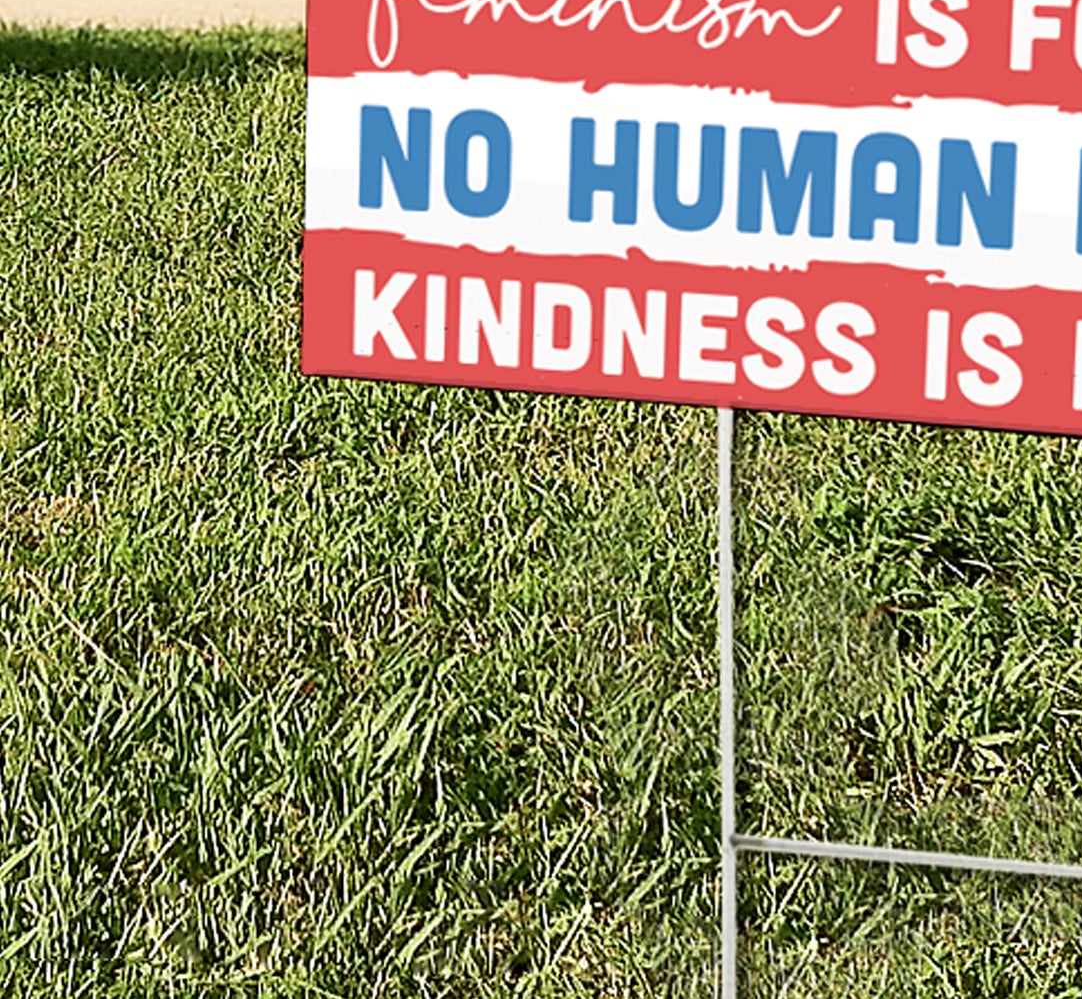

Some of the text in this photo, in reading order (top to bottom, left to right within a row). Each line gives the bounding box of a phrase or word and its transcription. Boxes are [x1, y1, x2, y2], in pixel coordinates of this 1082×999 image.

[358, 104, 513, 218] NO
[567, 117, 1018, 250] HUMAN
[353, 269, 876, 396] KINDNESS
[924, 309, 1023, 407] IS
